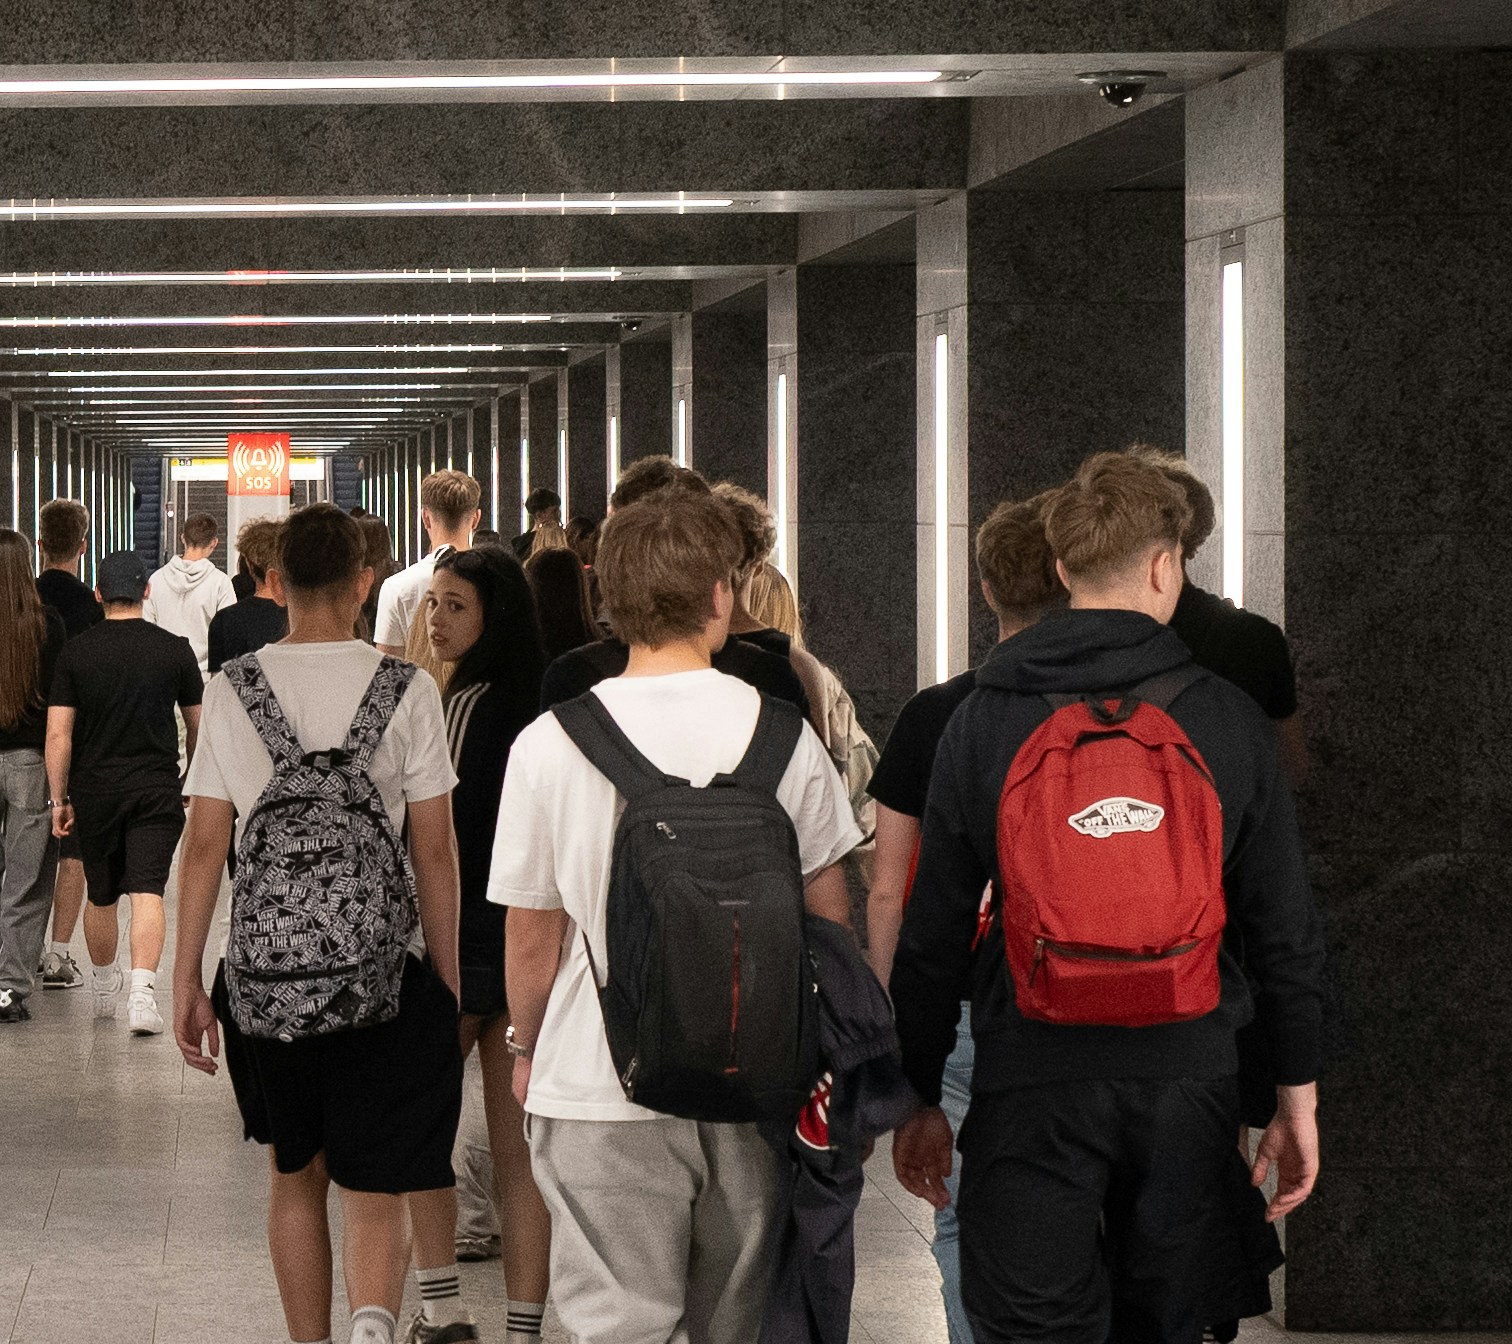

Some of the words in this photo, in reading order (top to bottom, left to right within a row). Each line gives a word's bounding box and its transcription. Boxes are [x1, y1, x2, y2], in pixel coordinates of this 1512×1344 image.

[246, 476, 272, 490] SOS
[1096, 803, 1129, 816] VANS
[1104, 813, 1129, 826] THE
[259, 919, 276, 933] THE
[272, 935, 289, 949] THE
